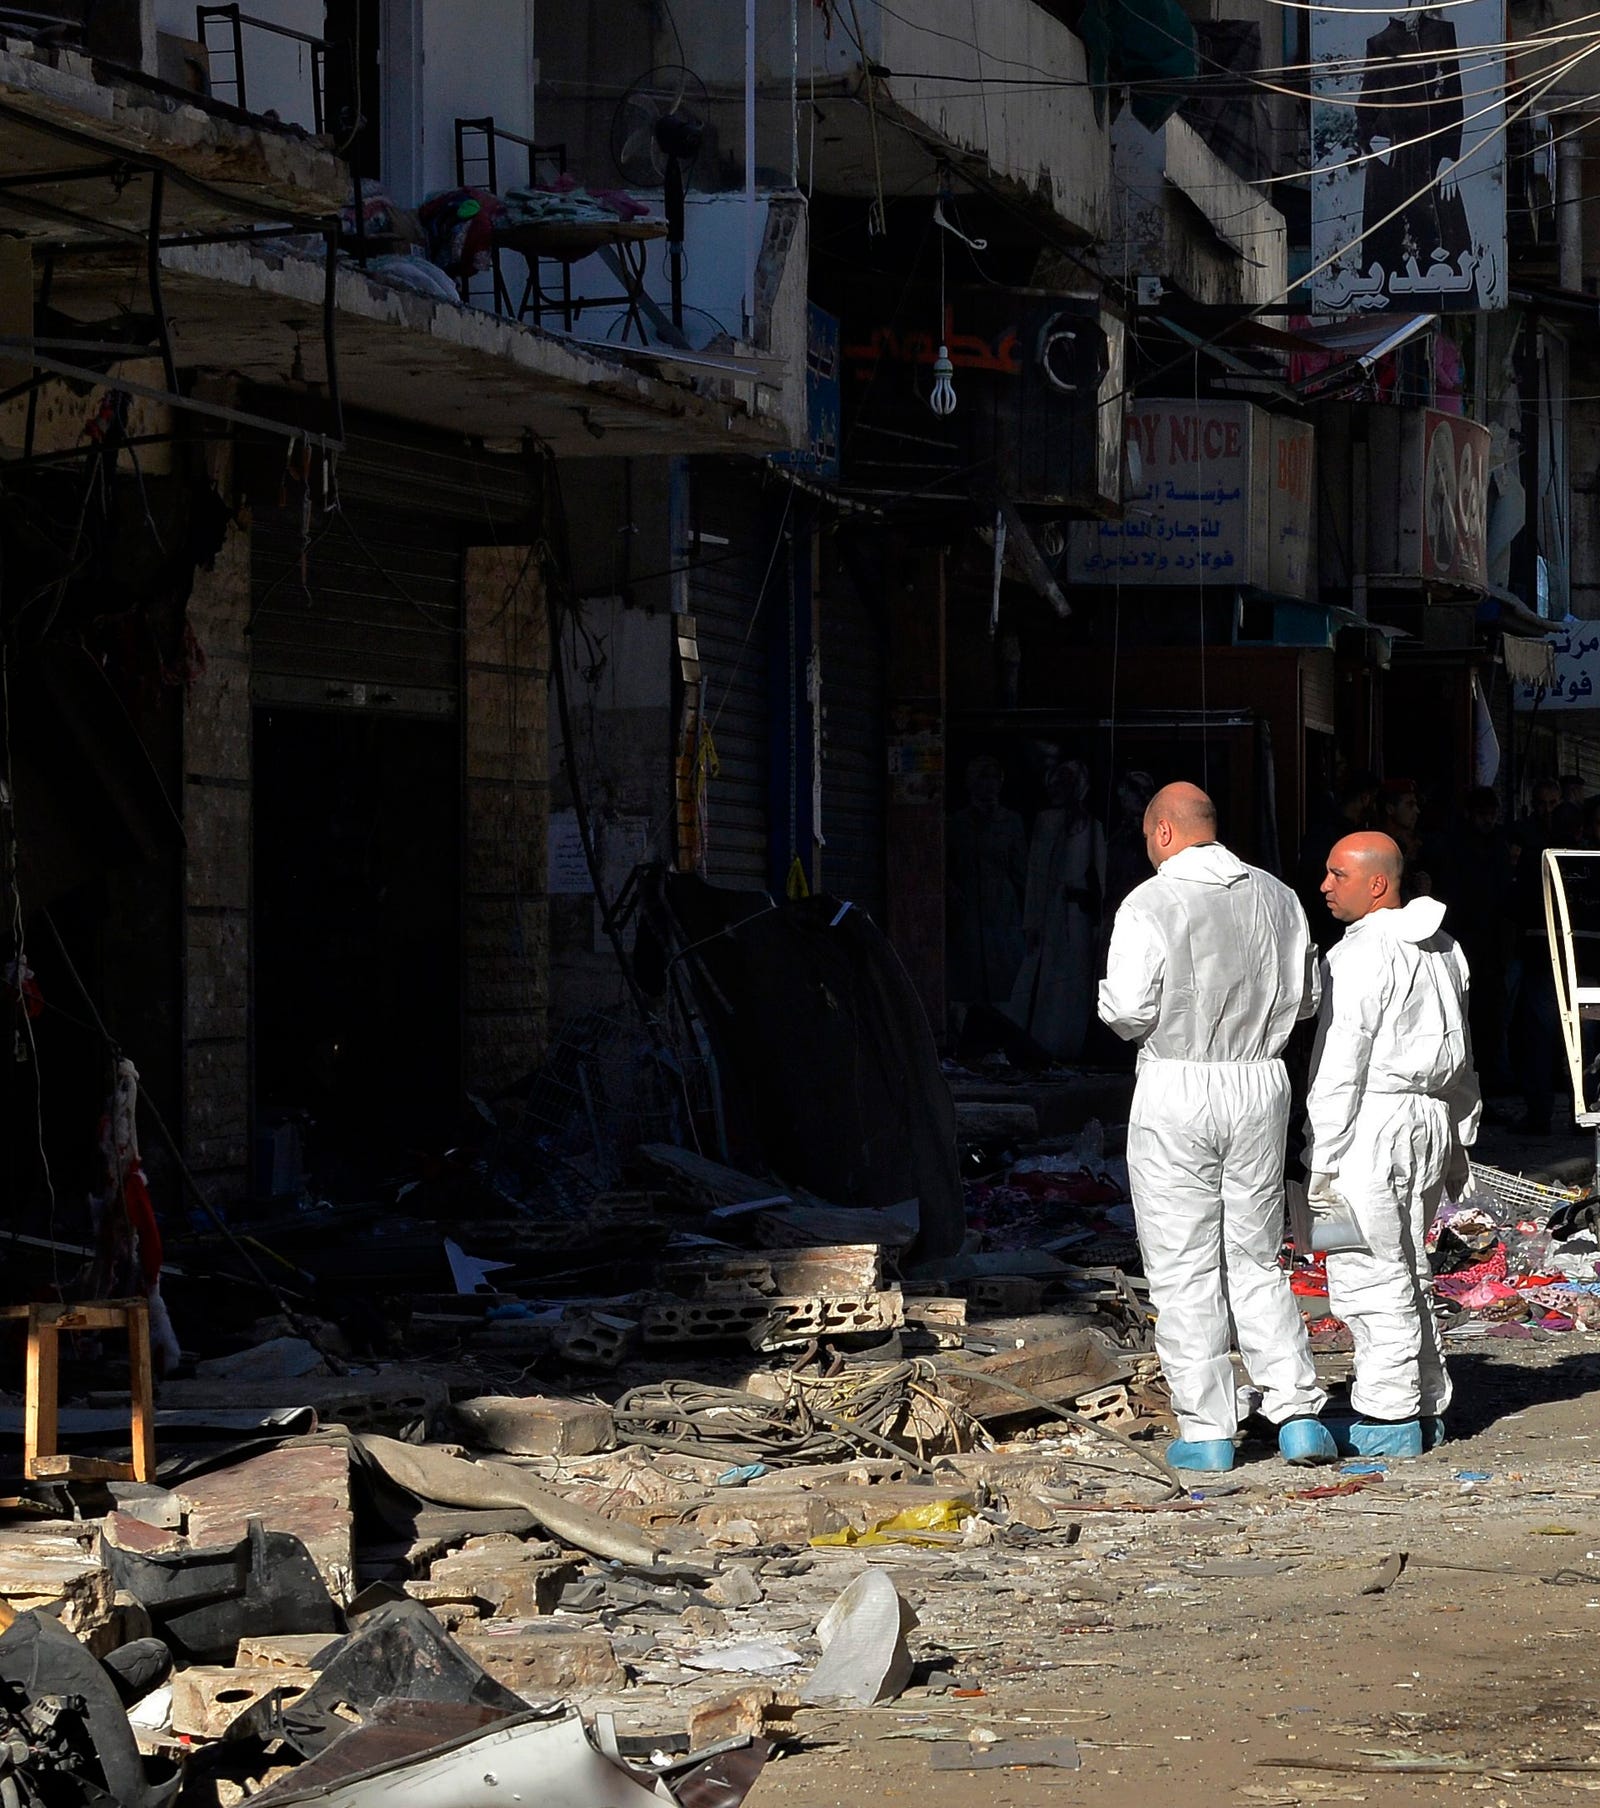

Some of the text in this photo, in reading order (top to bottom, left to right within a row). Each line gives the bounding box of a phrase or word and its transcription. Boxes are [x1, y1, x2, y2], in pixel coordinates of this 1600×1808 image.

[1168, 414, 1242, 465] NICE
[1165, 479, 1241, 506] مؤسسة
[1157, 517, 1220, 543] للتجارة
[1175, 550, 1235, 571] فولارد
